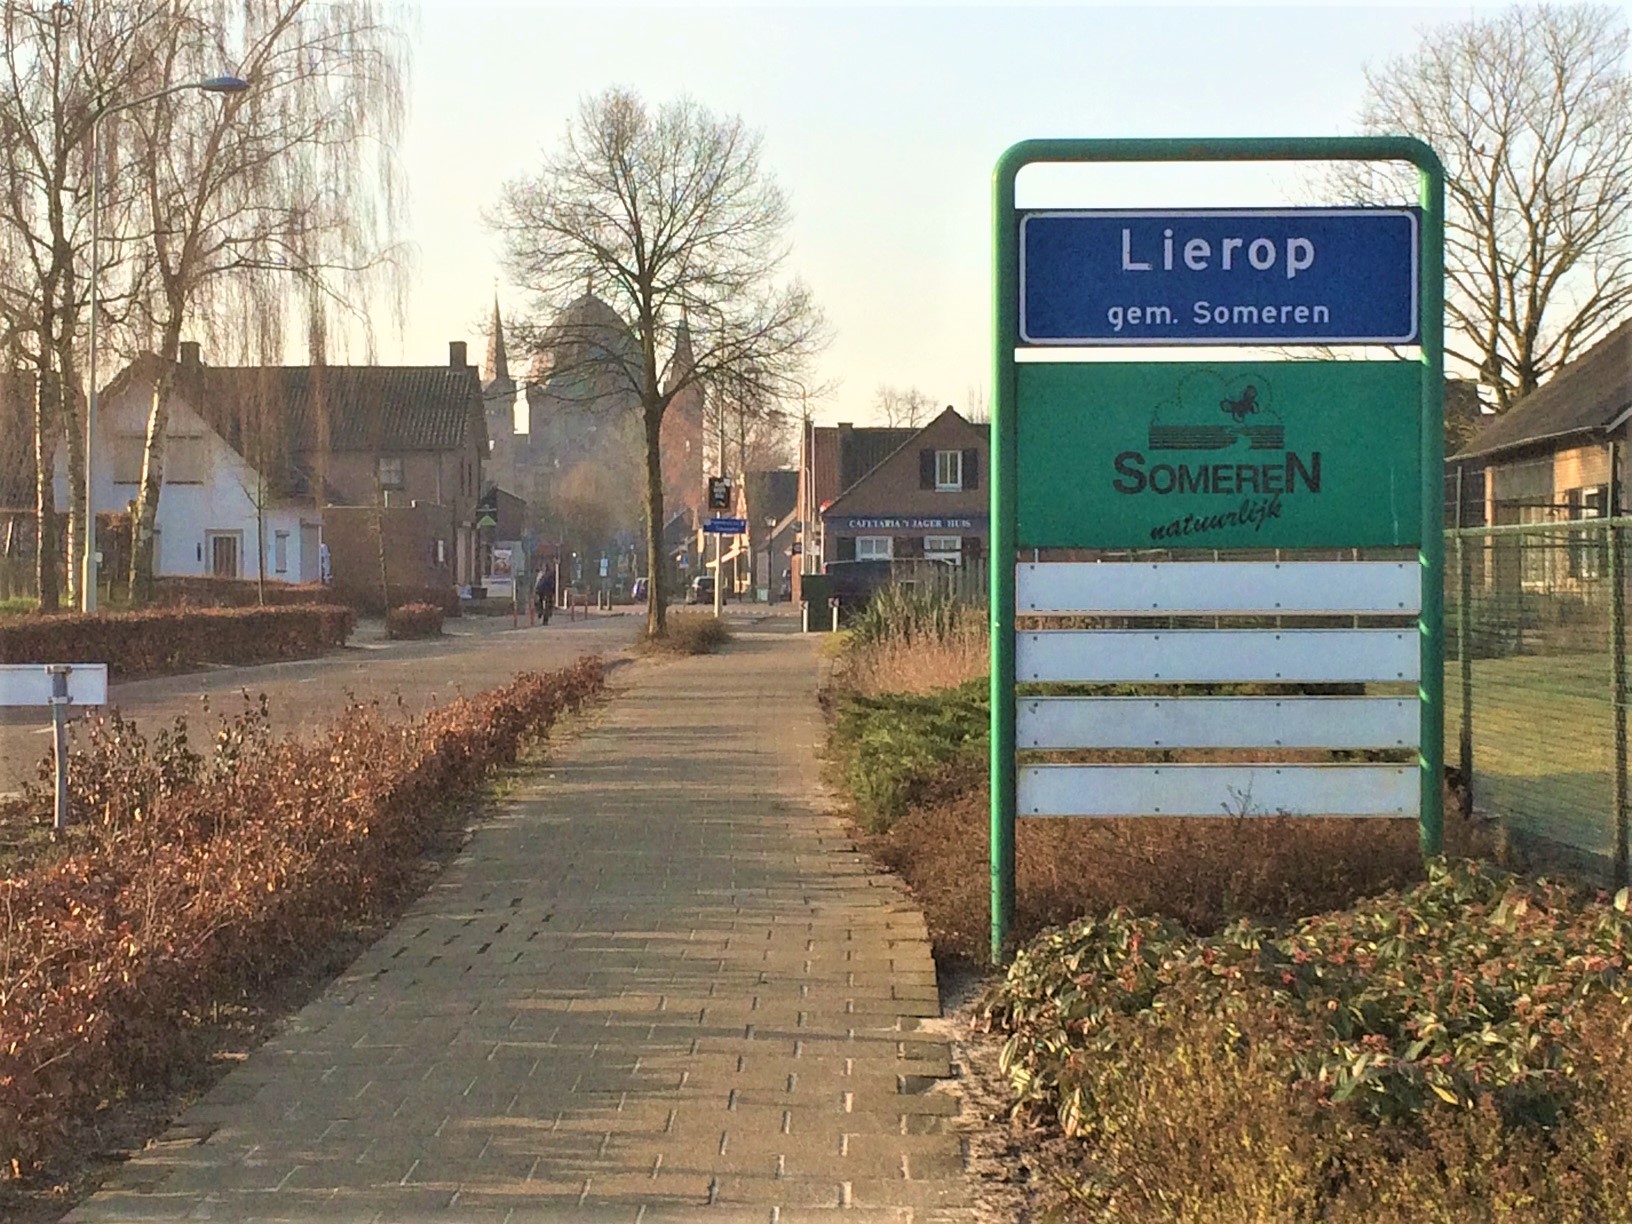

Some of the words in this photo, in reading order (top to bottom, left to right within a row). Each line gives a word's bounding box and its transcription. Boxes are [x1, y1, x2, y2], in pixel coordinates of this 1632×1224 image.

[1121, 229, 1315, 279] Lierop
[1107, 304, 1179, 331] gem.
[1192, 301, 1331, 325] Someren
[1150, 495, 1282, 540] natuurlijk
